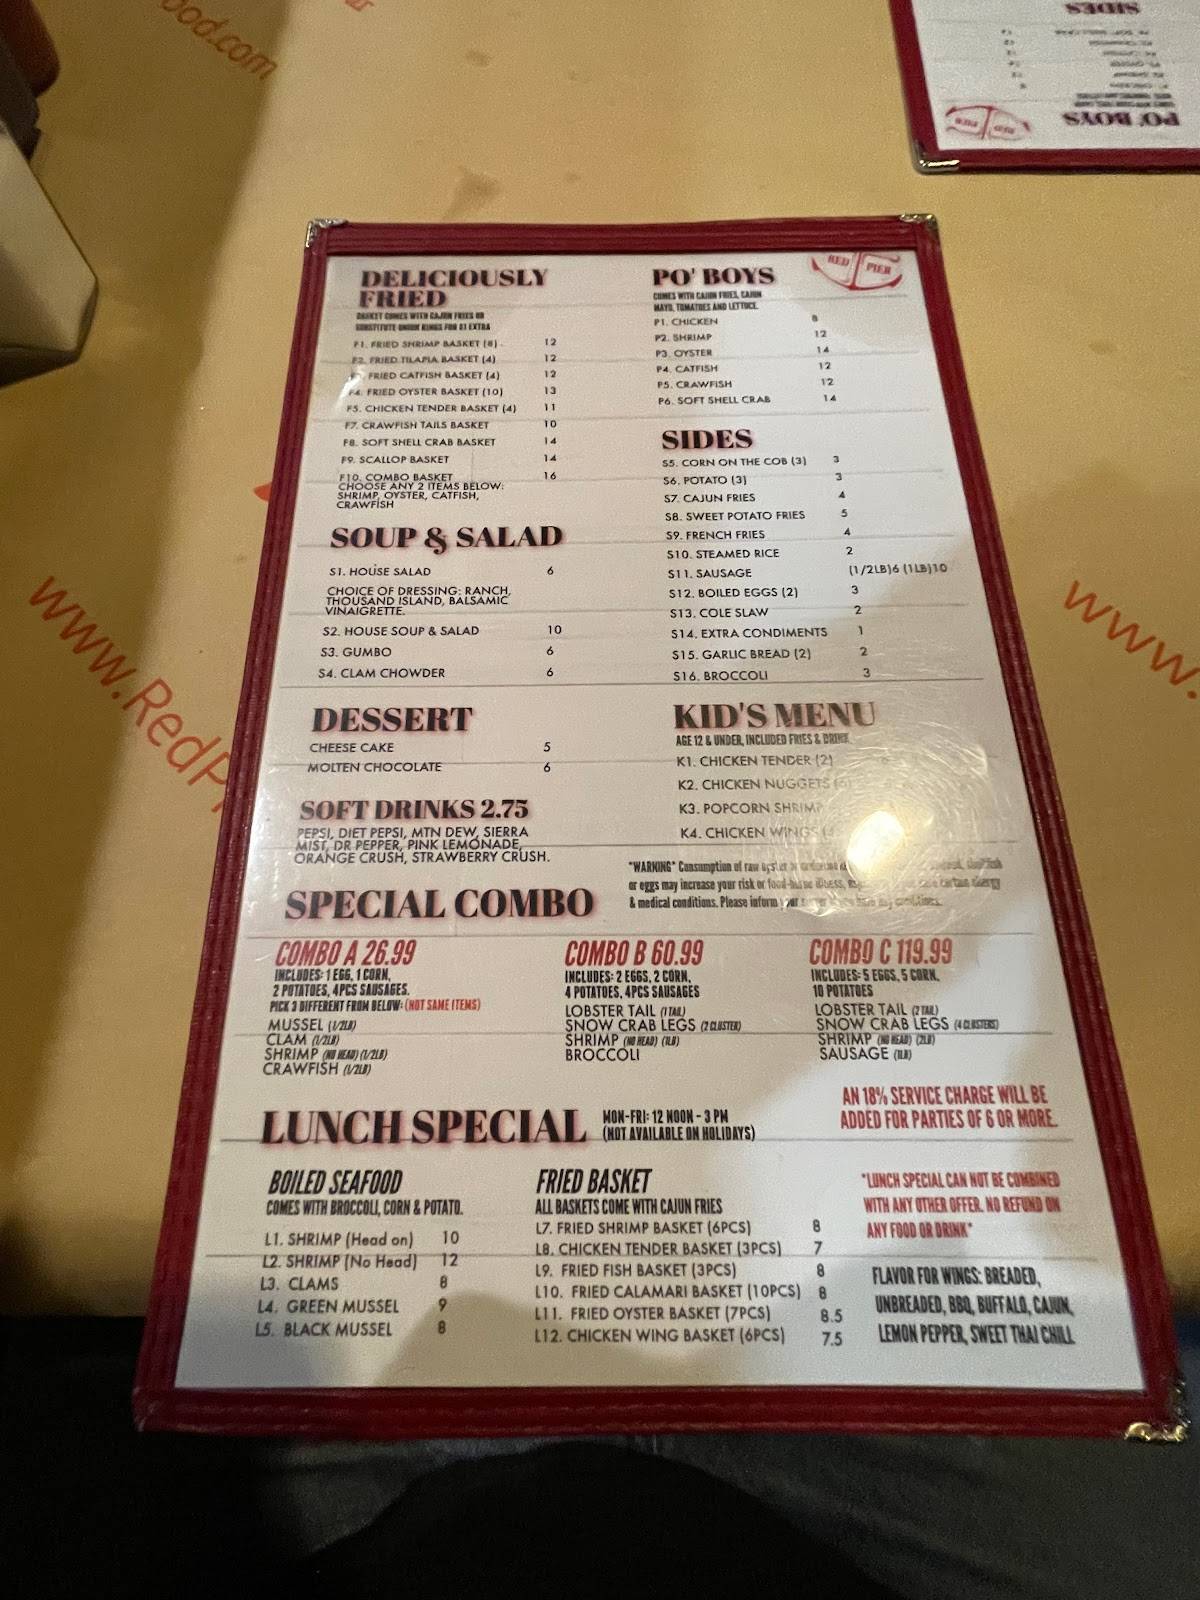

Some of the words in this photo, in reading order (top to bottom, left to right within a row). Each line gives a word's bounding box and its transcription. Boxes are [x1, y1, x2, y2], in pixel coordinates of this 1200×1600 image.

[1063, 111, 1132, 126] BOYS
[827, 254, 850, 267] RED
[866, 262, 892, 275] PIER
[361, 268, 548, 287] DELICIOUSLY
[652, 268, 695, 287] PO'
[701, 266, 775, 286] BOYS
[359, 290, 447, 308] FRIED
[674, 379, 733, 390] CRAWFISH
[821, 377, 834, 387] 12
[364, 404, 414, 414] CHICKEN
[416, 403, 457, 414] TENDER
[459, 403, 498, 413] BASKET
[501, 403, 517, 413] (4)
[544, 403, 556, 412] 11
[361, 438, 388, 448] SOFT
[391, 438, 421, 447] SHELL
[423, 437, 453, 447] CRAB
[455, 437, 496, 447] BASKET
[543, 436, 557, 446] 14
[661, 428, 753, 450] SIDES
[358, 455, 407, 465] SCALLOP
[408, 455, 450, 464] BASKET
[543, 453, 557, 462] 14
[680, 458, 716, 468] CORN
[717, 457, 738, 467] ON
[740, 457, 760, 467] THE
[762, 457, 788, 467] COB
[790, 456, 807, 466] (3)
[833, 455, 840, 464] 3
[330, 526, 418, 549] SOUP
[423, 525, 448, 554] &
[455, 524, 563, 548] SALAD
[666, 550, 692, 560] S10.
[695, 549, 751, 560] STEAMED
[753, 548, 780, 559] RICE
[845, 546, 854, 556] 2
[327, 585, 374, 596] CHOICE
[376, 585, 394, 596] OF
[396, 585, 461, 596] DRESSING:
[463, 585, 512, 596] RANCH,
[322, 626, 340, 637] S2.
[343, 625, 388, 637] HOUSE
[390, 625, 425, 637] SOUP
[427, 625, 437, 636] &
[439, 625, 480, 636] SALAD
[547, 624, 562, 635] 10
[671, 629, 698, 640] S14.
[700, 628, 740, 640] EXTRA
[741, 627, 828, 639] CONDIMENTS
[858, 625, 863, 636] 1
[318, 668, 336, 679] S4.
[339, 667, 376, 679] CLAM
[378, 667, 445, 679] CHOWDER
[546, 667, 554, 678] 6
[673, 671, 701, 682] S16.
[702, 670, 768, 682] BROCCOLI
[863, 667, 871, 678] 3
[29, 575, 231, 813] www.RedP
[311, 706, 473, 733] DESSERT
[673, 703, 769, 730] KID'S
[773, 702, 875, 729] MENU
[309, 742, 357, 753] CHEESE
[358, 742, 395, 753] CAKE
[543, 741, 551, 753] 5
[676, 755, 698, 768] K1.
[696, 755, 759, 768] CHICKEN
[761, 754, 812, 767] TENDER
[299, 799, 369, 820] SOFT
[373, 799, 477, 820] DRINKS
[479, 798, 529, 819] 2.75
[294, 851, 356, 864] ORANGE
[358, 851, 407, 864] CRUSH,
[411, 850, 498, 864] STRAWBERRY
[500, 850, 550, 863] CRUSH.
[285, 889, 445, 920] SPECIAL
[451, 887, 594, 919] COMBO
[275, 940, 345, 967] COMBO
[341, 940, 362, 966] A
[359, 939, 417, 966] 26.99
[565, 940, 632, 966] COMBO
[631, 940, 649, 966] B
[648, 939, 704, 965] 60.99
[809, 938, 876, 965] COMBO
[876, 938, 893, 965] C
[894, 938, 953, 965] 119.99
[565, 1004, 624, 1017] LOBSTER
[627, 1003, 657, 1017] TAIL
[267, 1018, 324, 1031] MUSSEL
[816, 1017, 866, 1031] SNOW
[868, 1017, 910, 1030] CRAB
[911, 1016, 950, 1030] LEGS
[266, 1033, 307, 1046] CLAM
[565, 1048, 640, 1062] BROCCOLI
[819, 1047, 889, 1061] SAUSAGE
[262, 1061, 339, 1076] CRAWFISH
[842, 1086, 861, 1106] AN
[861, 1086, 889, 1106] 18%
[889, 1085, 942, 1106] SERVICE
[943, 1085, 995, 1105] CHARGE
[996, 1084, 1027, 1104] WILL
[1028, 1084, 1049, 1104] BE
[262, 1109, 405, 1145] LUNCH
[410, 1108, 587, 1144] SPECIAL
[840, 1110, 883, 1130] ADDED
[883, 1109, 909, 1130] FOR
[909, 1109, 965, 1129] PARTIES
[965, 1109, 983, 1129] OF
[983, 1109, 995, 1129] 6
[994, 1108, 1015, 1129] OR
[1015, 1108, 1058, 1128] MORE.
[268, 1169, 329, 1195] BOILED
[326, 1169, 403, 1195] SEAFOOD
[536, 1169, 586, 1194] FRIED
[584, 1168, 652, 1194] BASKET
[535, 1199, 553, 1215] ALL
[553, 1199, 601, 1215] BASKETS
[599, 1198, 630, 1215] COME
[630, 1198, 659, 1215] WITH
[658, 1198, 693, 1215] CAJUN
[692, 1198, 723, 1214] FRIES
[535, 1221, 553, 1235] L7.
[555, 1221, 594, 1235] FRIED
[597, 1221, 649, 1235] SHRIMP
[652, 1221, 702, 1235] BASKET
[706, 1221, 751, 1234] (6PCS)
[812, 1220, 821, 1233] 8
[264, 1232, 282, 1247] L1.
[286, 1232, 342, 1247] SHRIMP
[344, 1232, 388, 1247] (Head
[390, 1232, 414, 1247] on)
[442, 1230, 460, 1245] 10
[872, 1266, 916, 1285] FLAVOR
[915, 1266, 940, 1285] FOR
[940, 1266, 982, 1286] WINGS:
[257, 1299, 281, 1314] L4.
[284, 1299, 339, 1314] GREEN
[340, 1299, 400, 1314] MUSSEL
[438, 1298, 447, 1312] 9
[534, 1329, 562, 1343] L12.
[566, 1329, 633, 1343] CHICKEN
[635, 1329, 679, 1343] WING
[681, 1328, 735, 1343] BASKET
[738, 1328, 785, 1342] (6PCS)
[822, 1331, 843, 1346] 7.5
